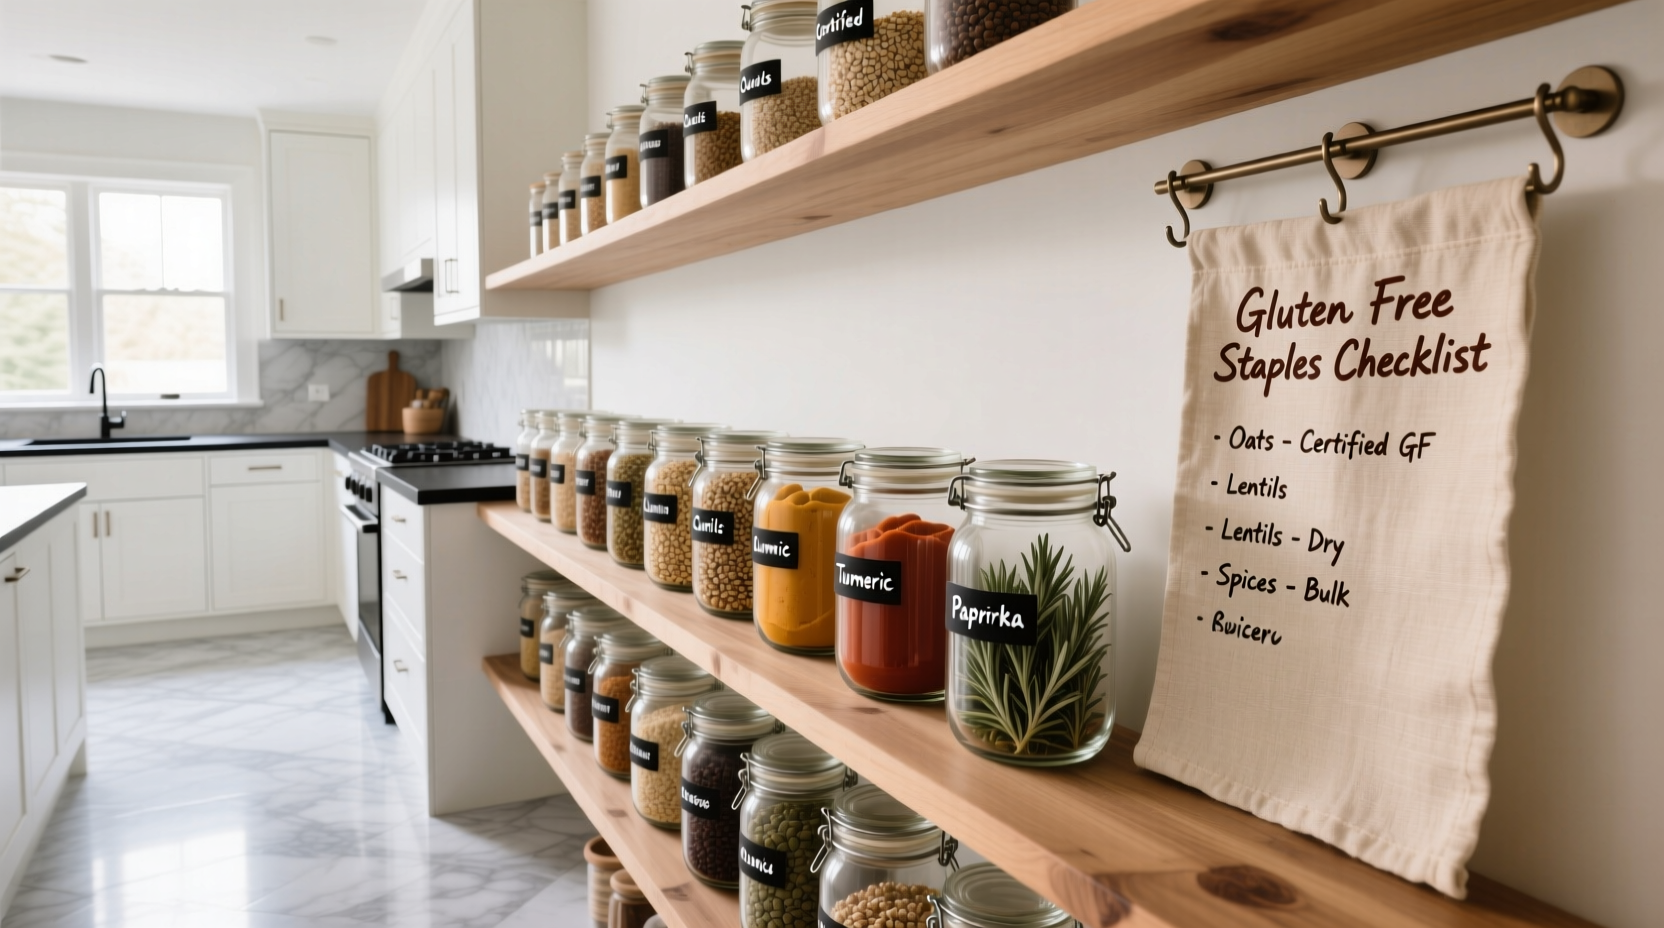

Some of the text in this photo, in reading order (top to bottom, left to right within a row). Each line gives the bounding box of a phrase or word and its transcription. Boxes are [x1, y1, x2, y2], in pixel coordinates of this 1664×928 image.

[1236, 275, 1454, 338] Gluten Free
[1213, 332, 1492, 398] Staples Checklist
[1228, 425, 1275, 452] Oats
[1300, 428, 1390, 461] Certified
[1398, 431, 1437, 464] GF
[1226, 472, 1288, 500] Lentils
[1221, 517, 1283, 547] Lentils
[1307, 527, 1345, 567] Dry
[835, 562, 895, 592] Tumeric
[1215, 562, 1277, 599] Spices
[1303, 576, 1350, 608] Bulk
[952, 594, 1025, 630] Paprirka
